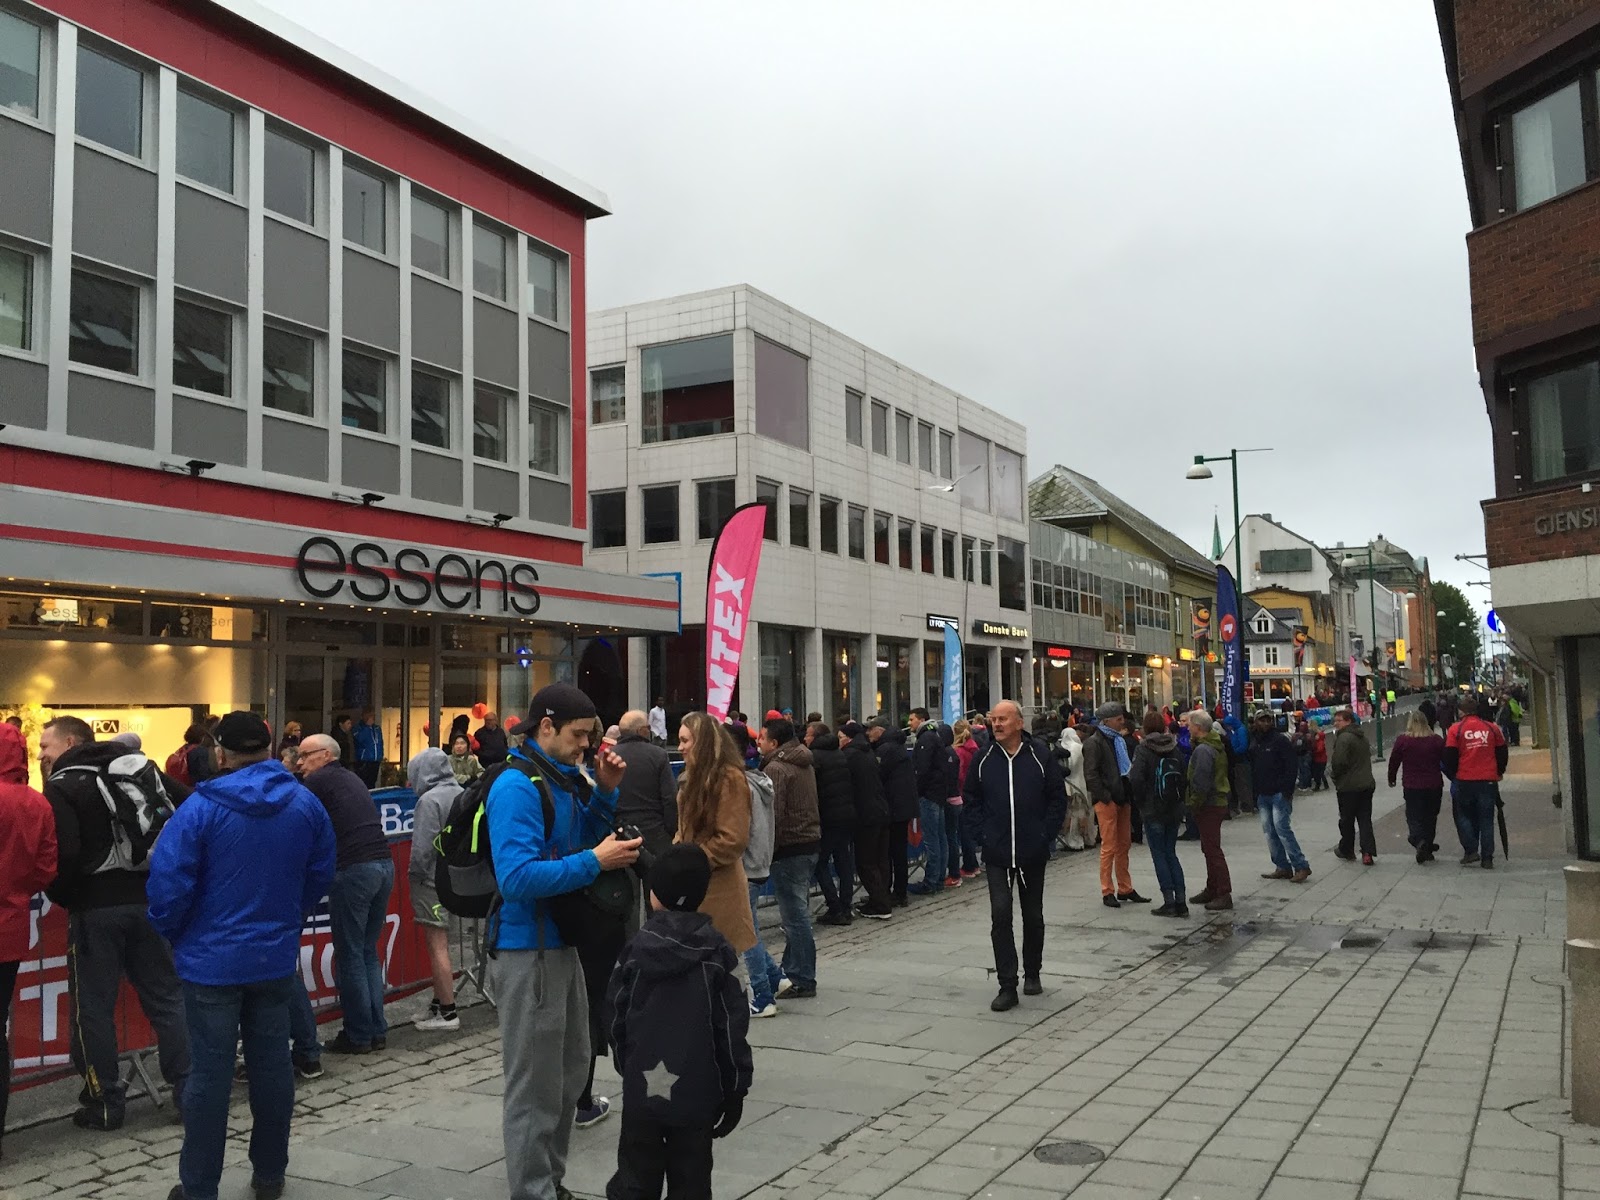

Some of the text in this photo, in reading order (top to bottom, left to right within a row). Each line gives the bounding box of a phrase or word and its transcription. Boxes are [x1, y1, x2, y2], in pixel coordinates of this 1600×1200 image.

[1535, 507, 1600, 535] GJENSI
[299, 537, 540, 615] essens
[706, 562, 746, 720] MTEX
[983, 623, 1028, 638] Danske Bank
[93, 720, 143, 733] PCA skin
[380, 803, 415, 835] Ba
